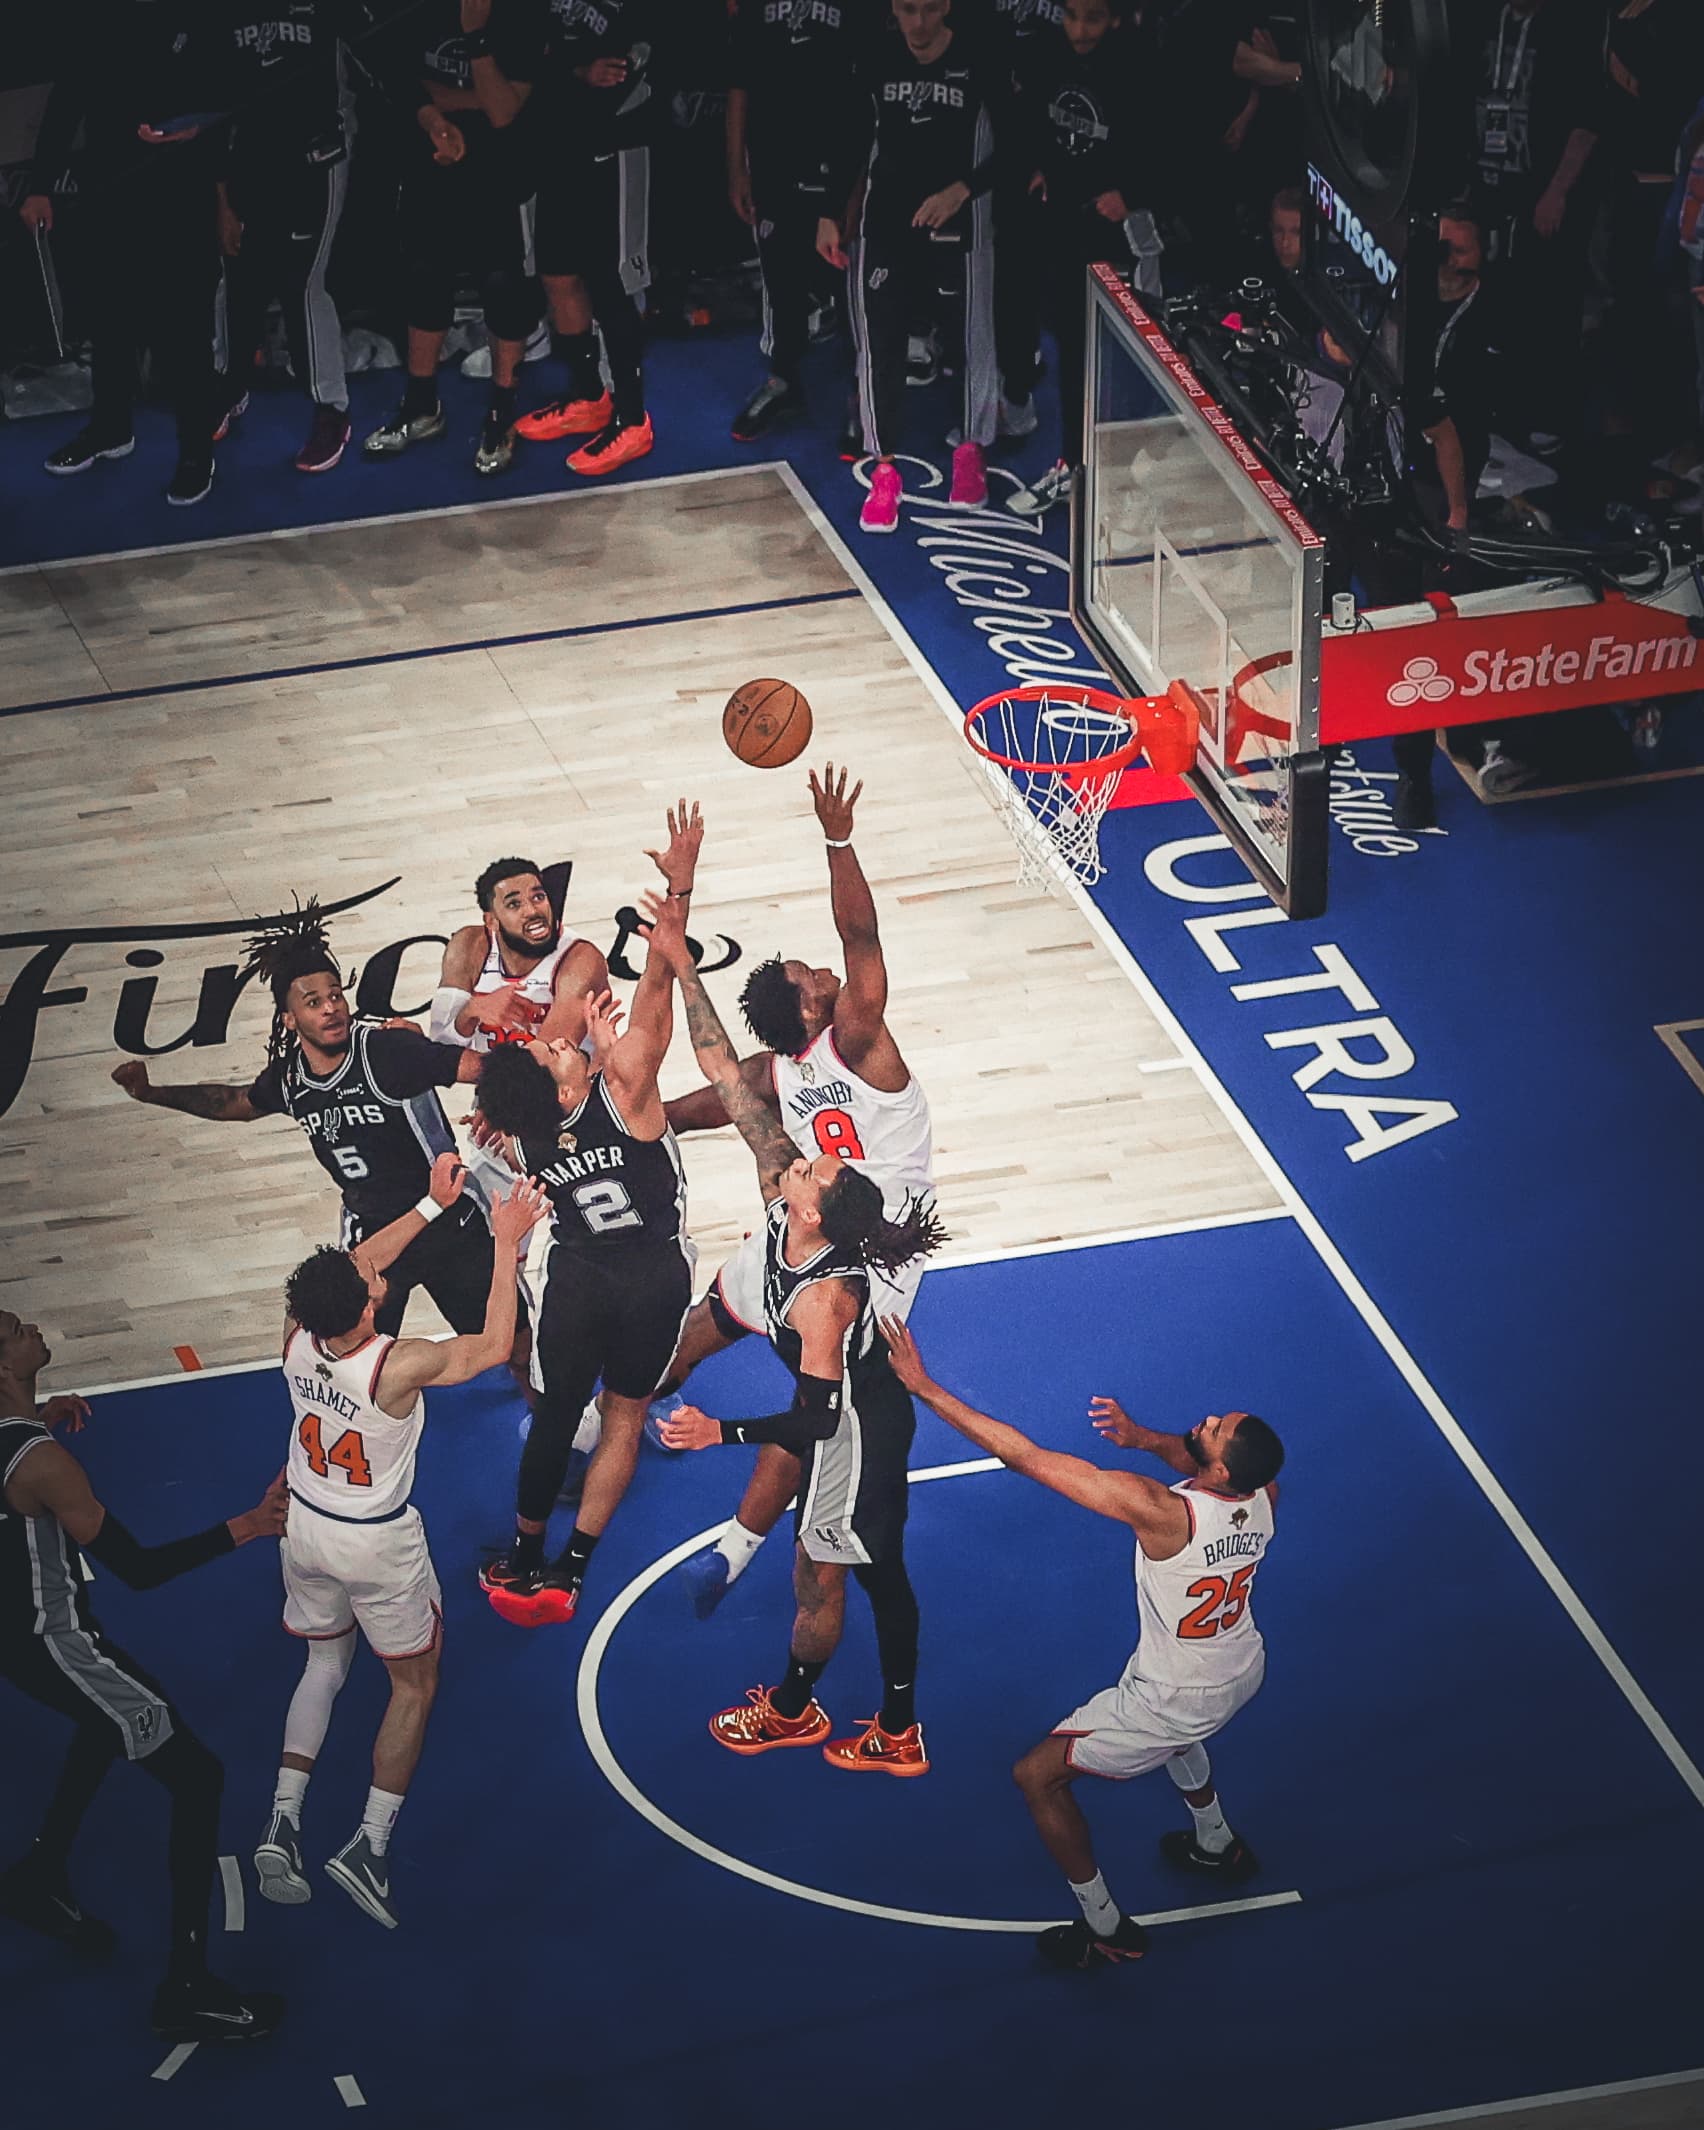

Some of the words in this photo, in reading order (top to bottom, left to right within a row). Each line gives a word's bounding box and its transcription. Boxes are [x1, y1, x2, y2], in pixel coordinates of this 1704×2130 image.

[883, 80, 964, 112] SPURS
[1143, 833, 1460, 1163] ULTRA
[299, 1104, 385, 1144] SPURS
[811, 1108, 866, 1161] 8
[332, 1145, 369, 1180] 5
[540, 1145, 625, 1187] HARPER
[571, 1178, 645, 1235] 2
[294, 1375, 361, 1421] SHAMET
[298, 1412, 372, 1487] 44
[1203, 1532, 1264, 1567] BRIDGES
[1176, 1560, 1256, 1639] 25
